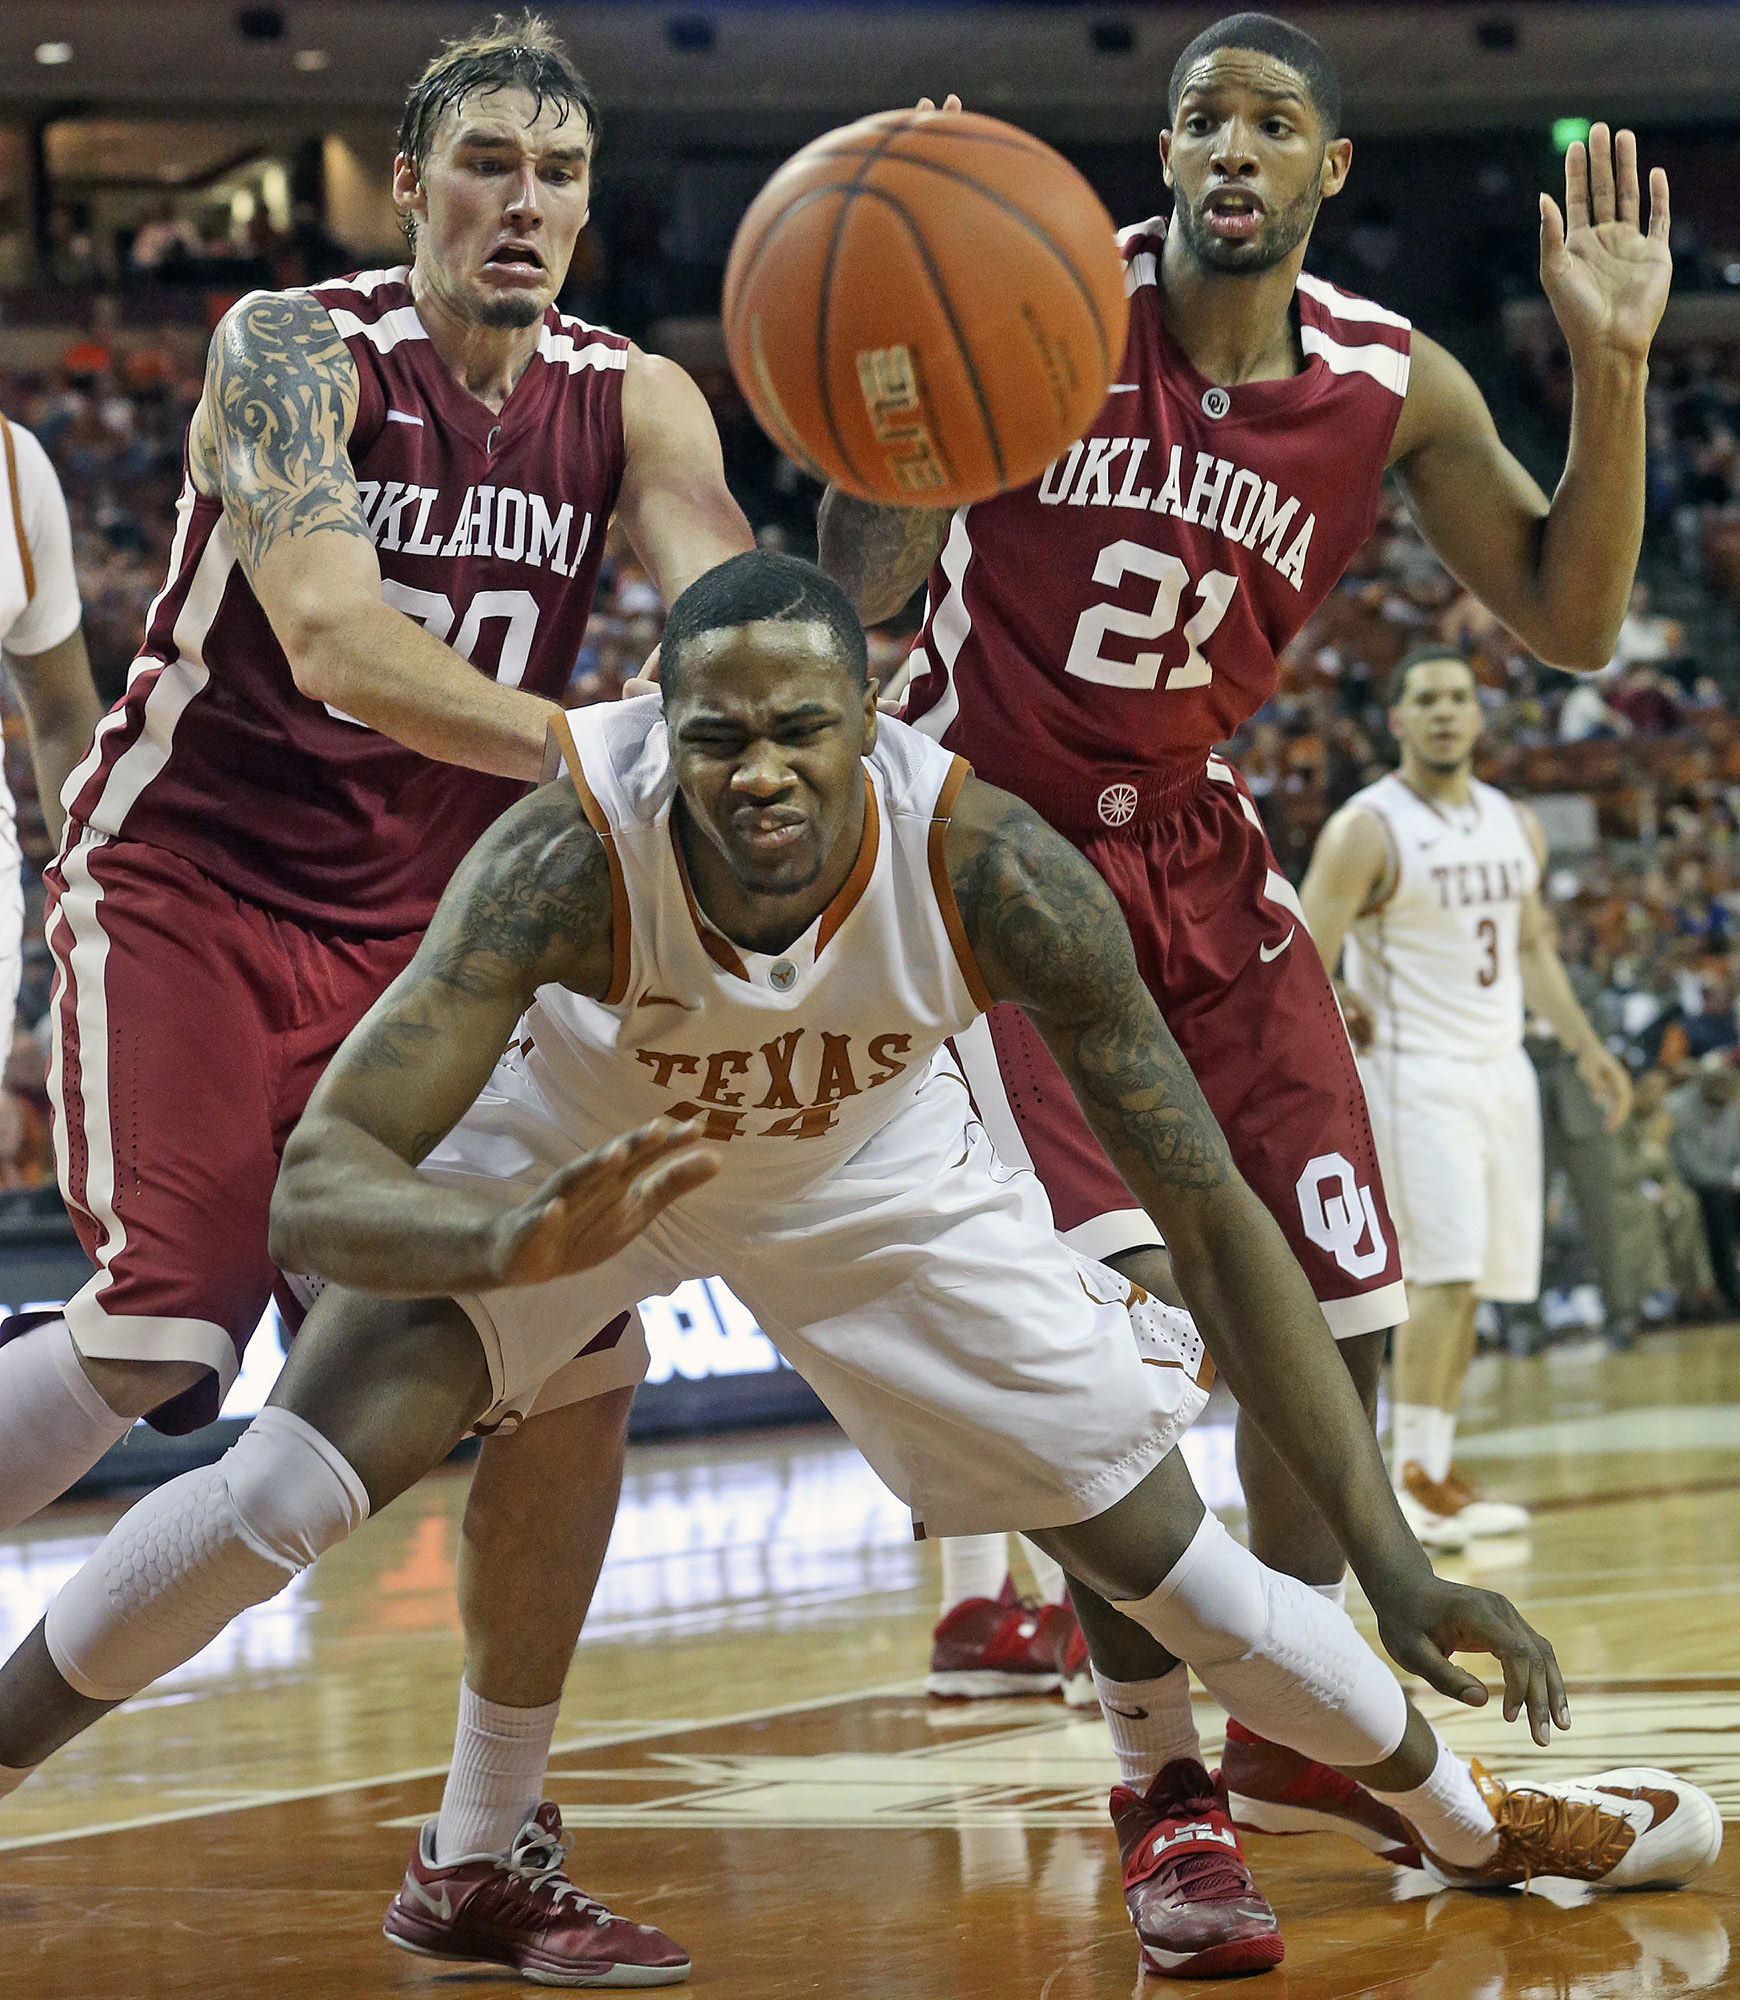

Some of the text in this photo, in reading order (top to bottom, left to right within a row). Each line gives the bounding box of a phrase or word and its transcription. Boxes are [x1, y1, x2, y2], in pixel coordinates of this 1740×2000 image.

[1038, 437, 1316, 592] OKLAHOMA
[1065, 539, 1238, 690] 21
[1431, 861, 1523, 911] TEXA
[1476, 917, 1499, 988] 3
[634, 1028, 912, 1110] TEXAS
[1295, 1151, 1388, 1280] OU
